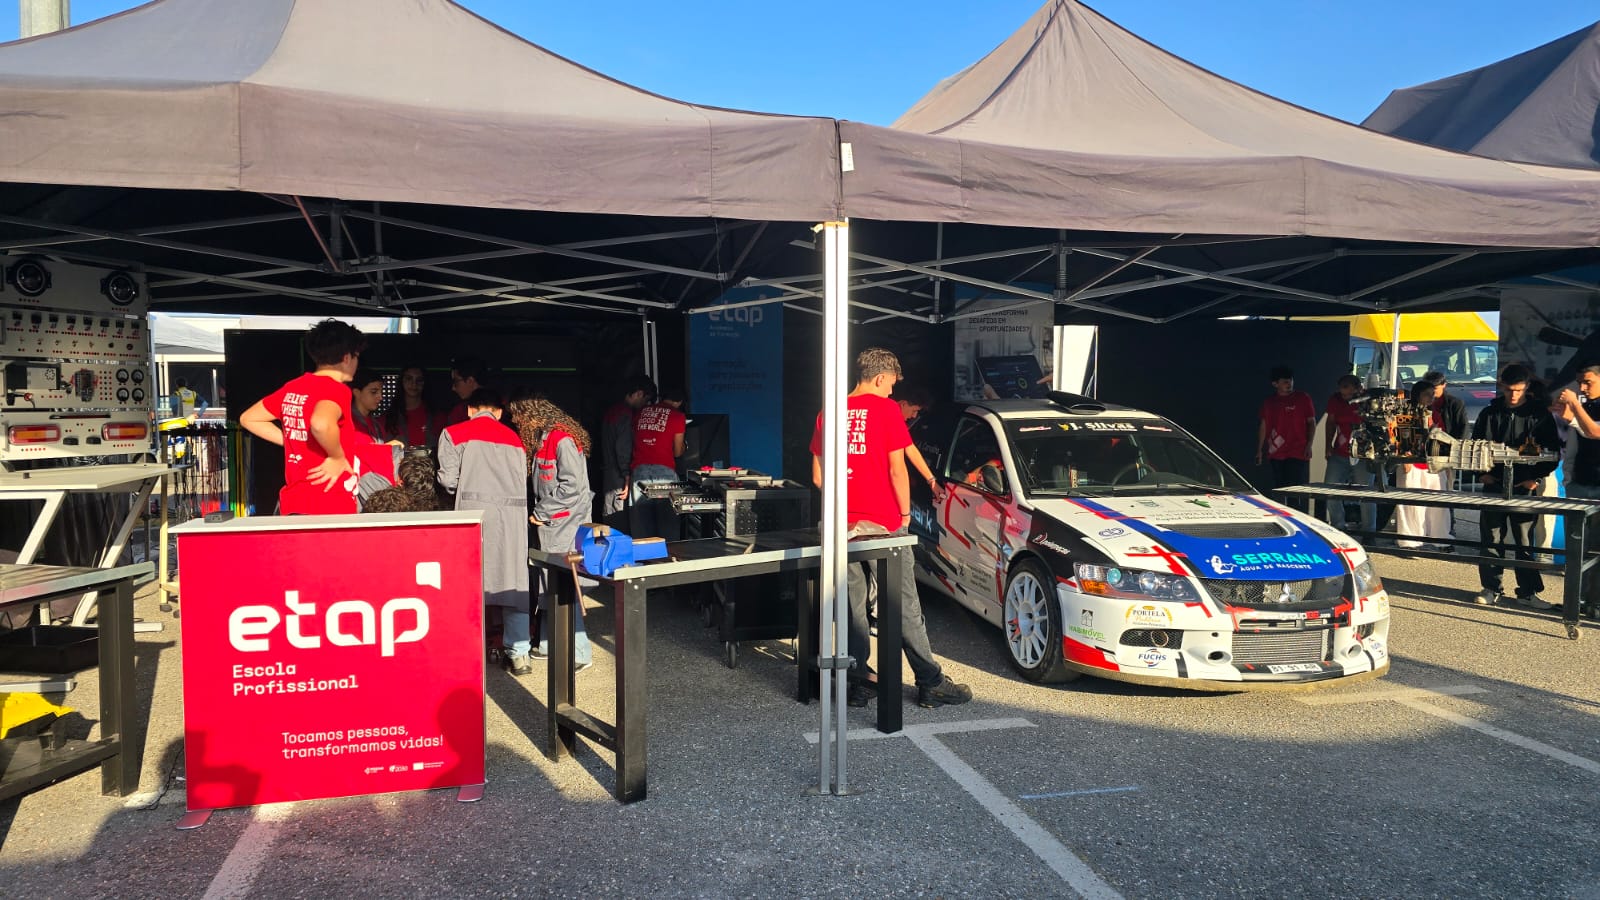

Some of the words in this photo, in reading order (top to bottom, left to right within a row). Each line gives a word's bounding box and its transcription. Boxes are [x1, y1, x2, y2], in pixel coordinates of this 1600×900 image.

[854, 420, 866, 431] IS
[851, 432, 866, 443] IN
[848, 443, 866, 455] RLD
[1232, 552, 1327, 567] SERRANA
[1133, 609, 1166, 617] PORTELA
[229, 589, 430, 657] etap
[1138, 653, 1167, 661] FUCHS
[233, 662, 296, 678] Escola
[233, 675, 359, 696] Profissional
[282, 730, 343, 745] Tocamos
[347, 725, 408, 743] pessoas,
[282, 740, 396, 759] transformamos
[400, 734, 443, 750] vidas!
